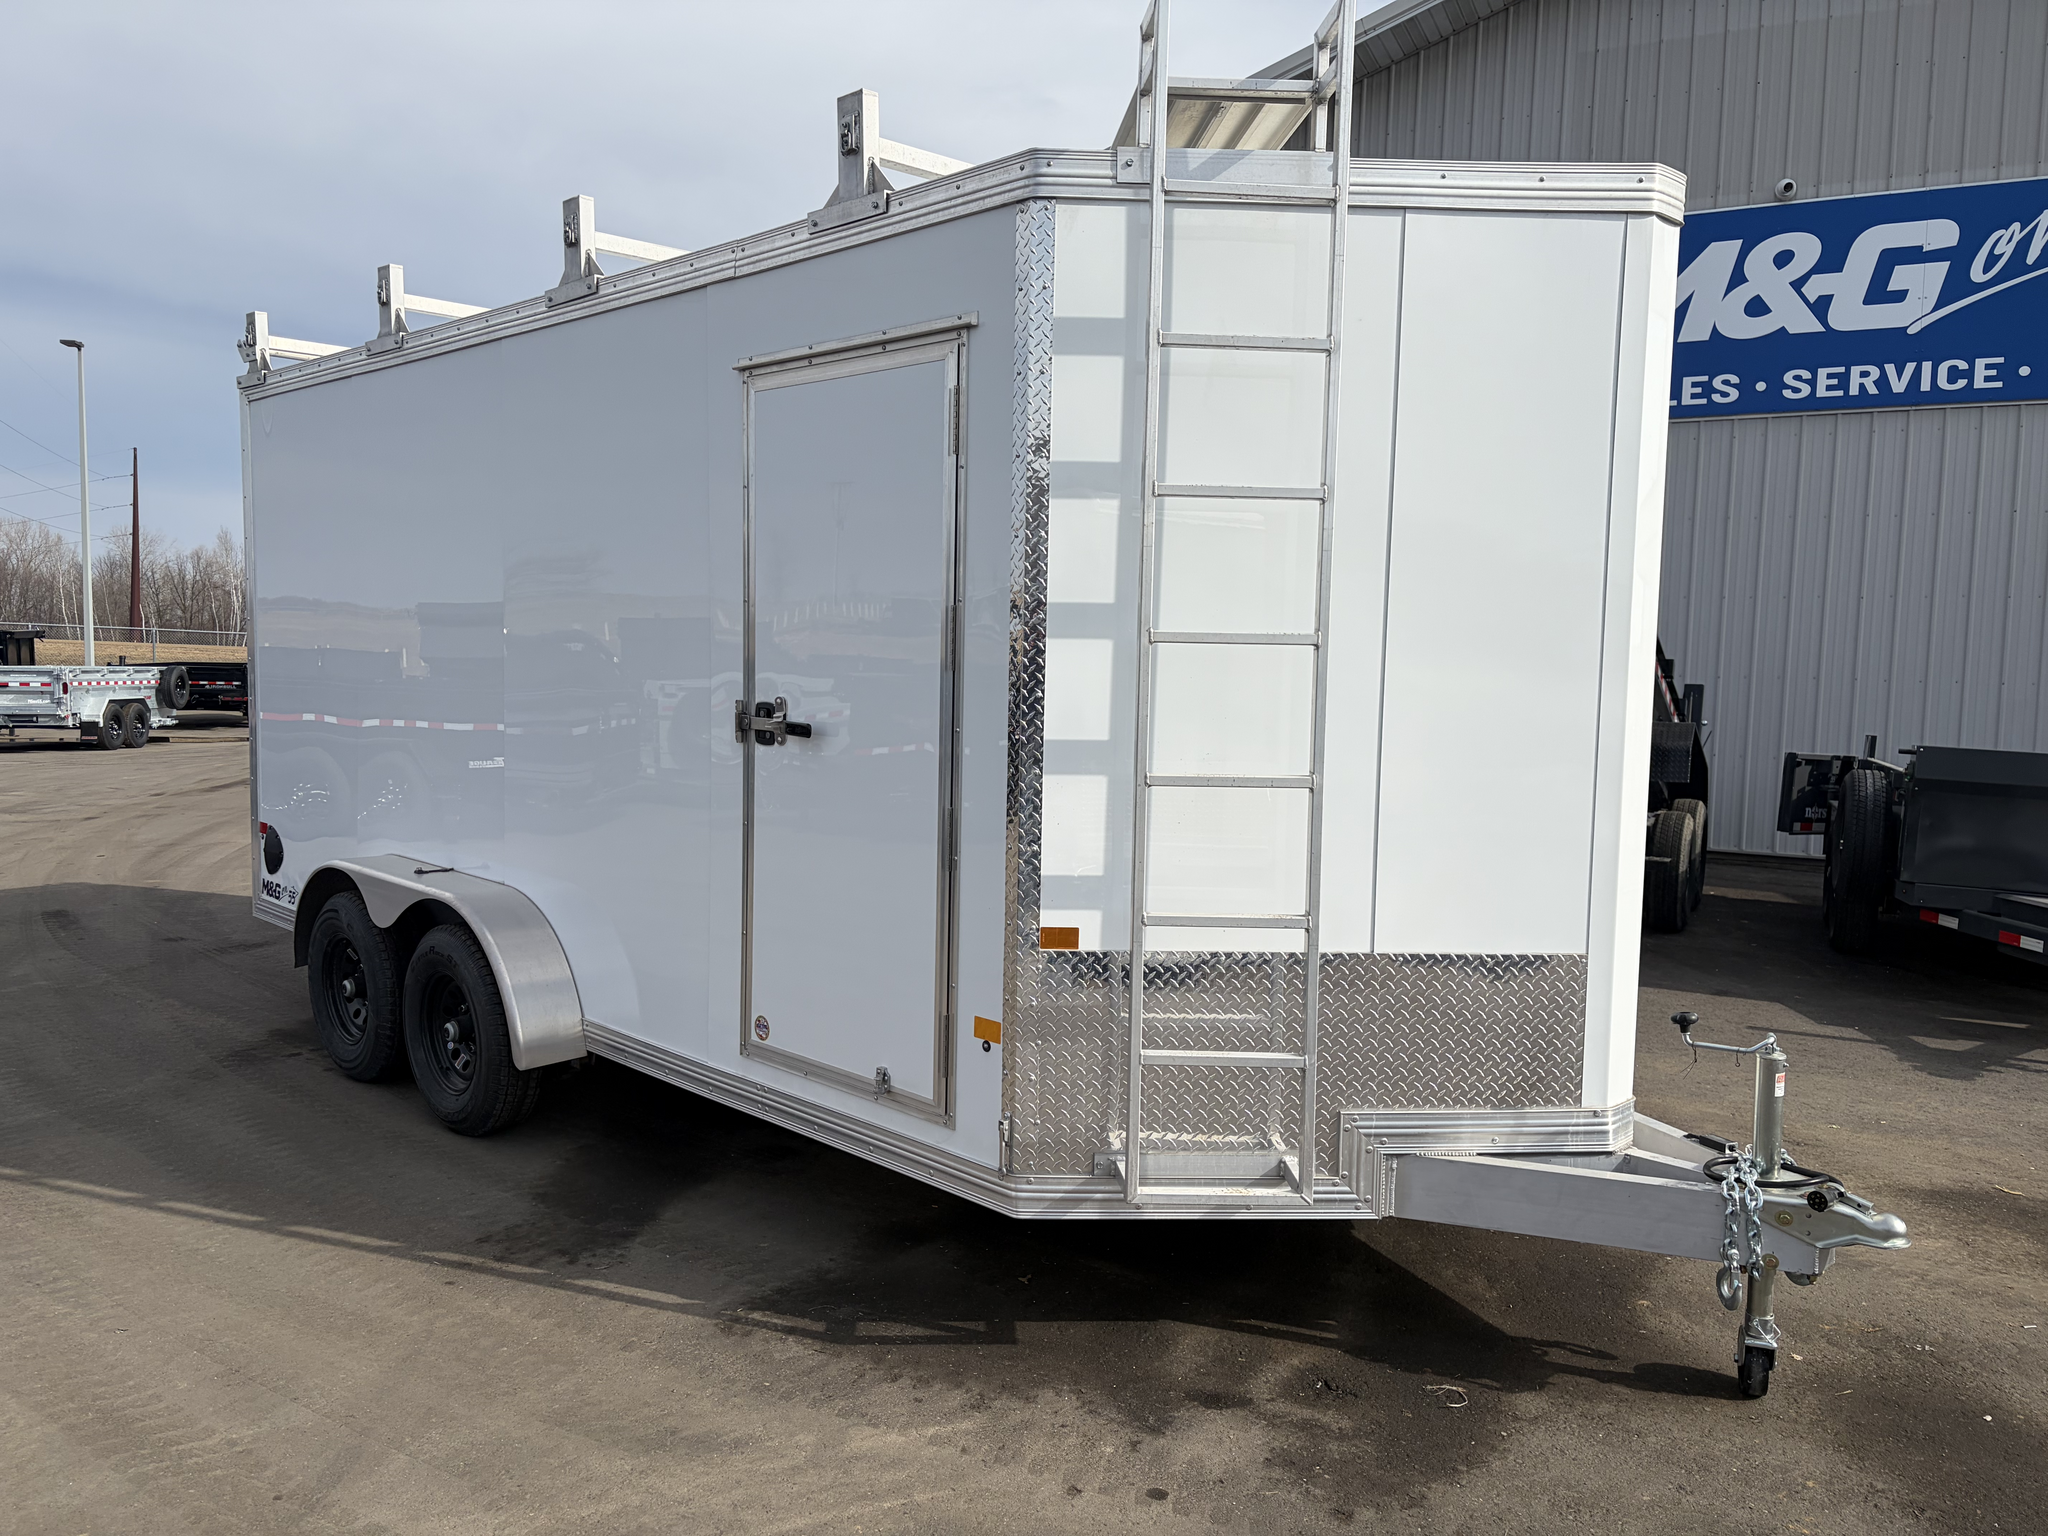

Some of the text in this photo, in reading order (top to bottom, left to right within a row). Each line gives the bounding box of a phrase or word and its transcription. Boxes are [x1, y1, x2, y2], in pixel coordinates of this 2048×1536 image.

[1669, 356, 2005, 406] ES SERVICE
[261, 878, 281, 900] M&G
